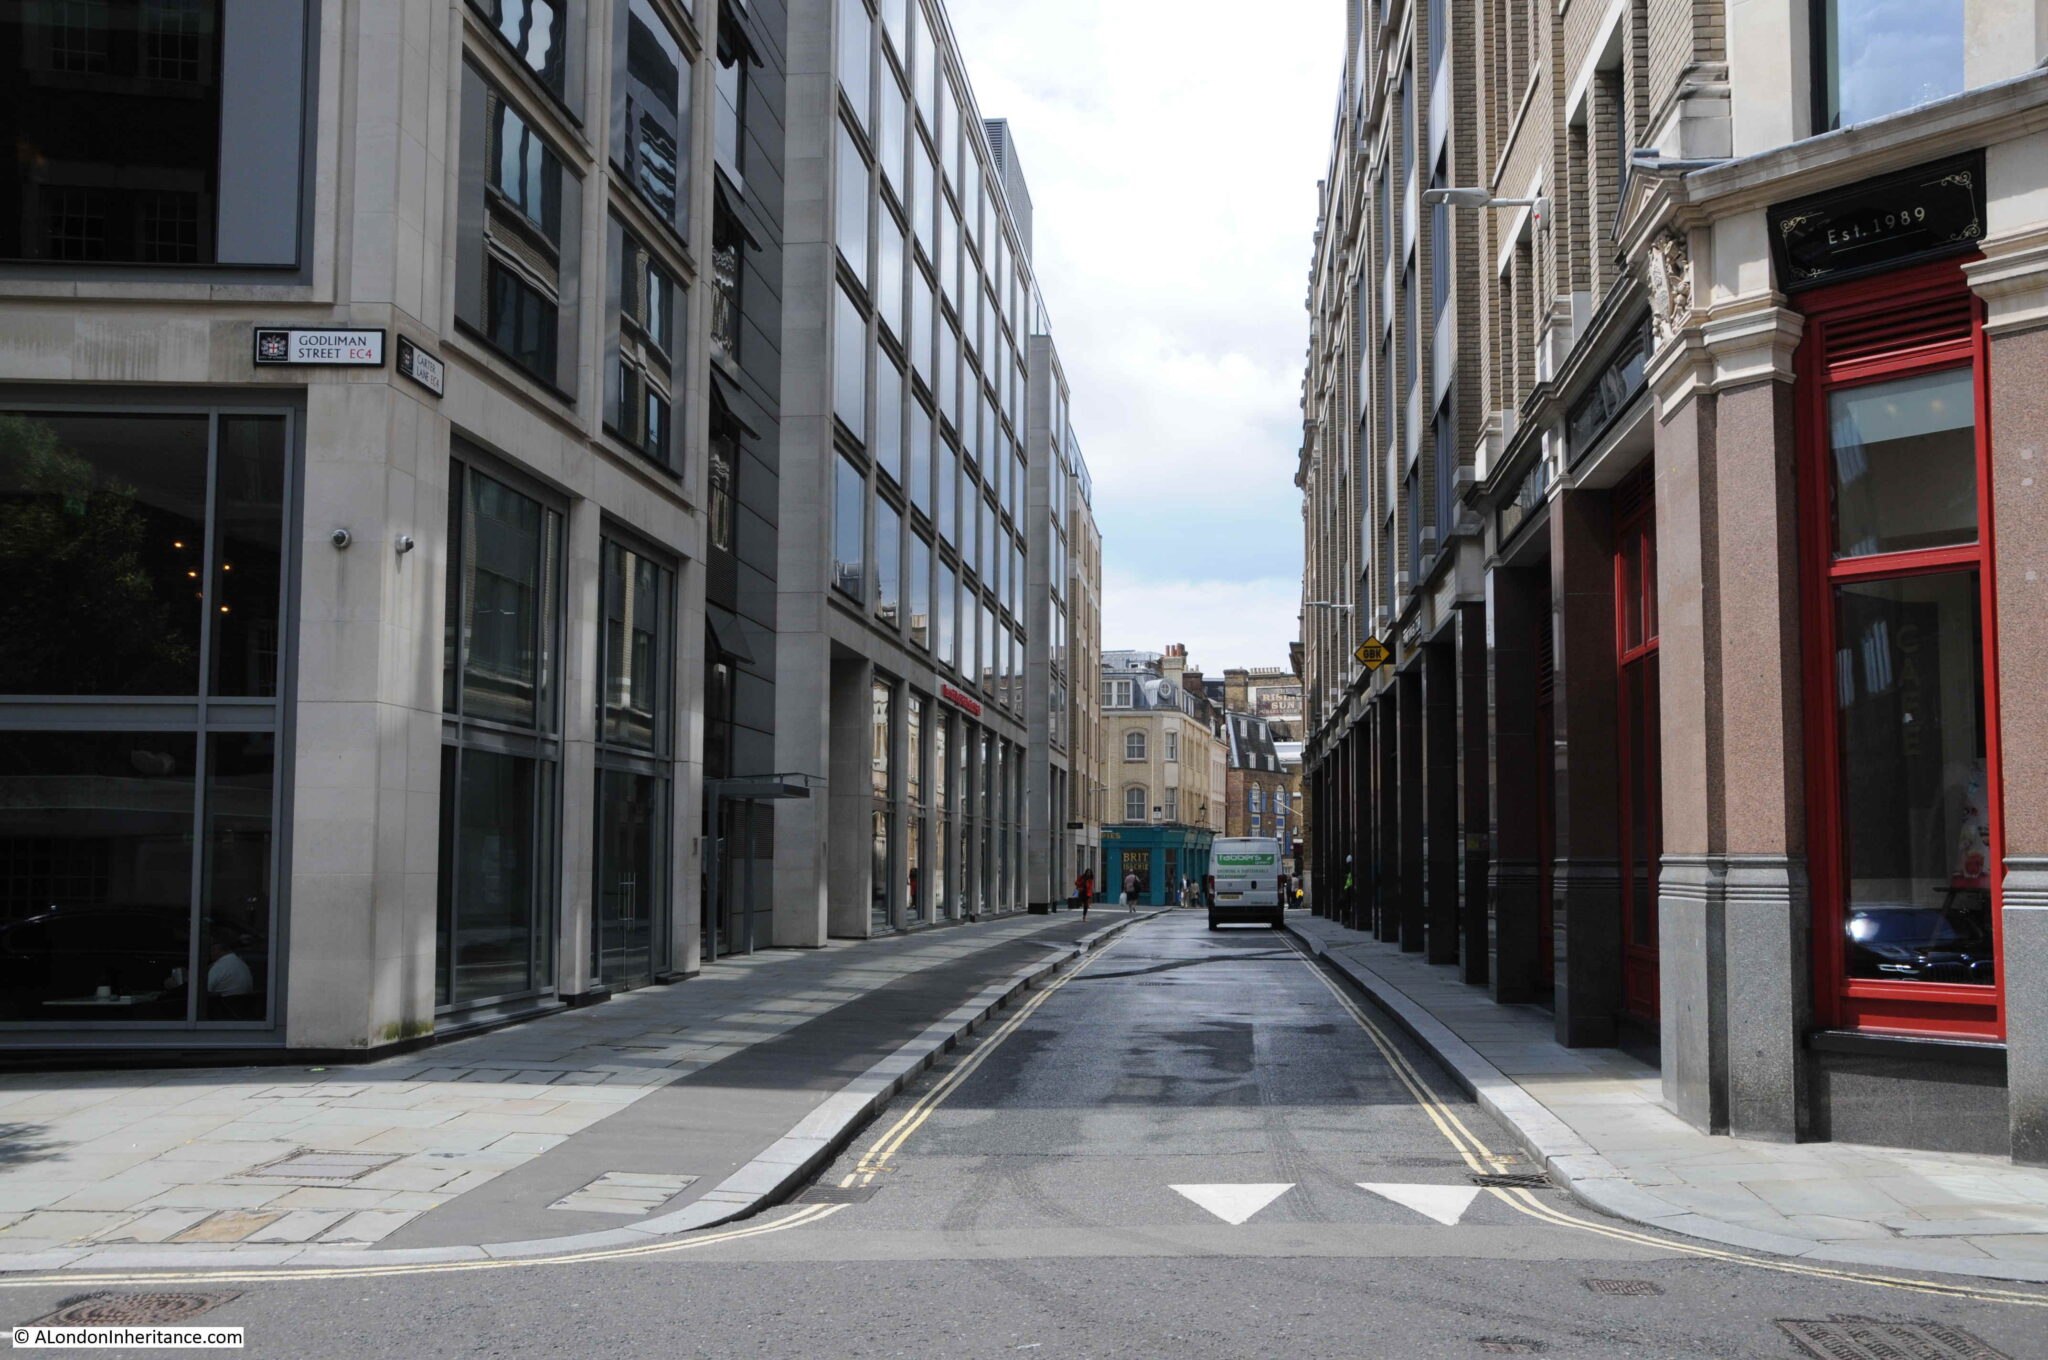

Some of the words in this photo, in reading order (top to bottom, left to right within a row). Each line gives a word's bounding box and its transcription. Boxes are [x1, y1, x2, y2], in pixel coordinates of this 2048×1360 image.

[1827, 225, 1867, 245] Est.
[1874, 207, 1926, 234] 1989
[298, 335, 367, 347] GODLIMAN
[298, 347, 342, 359] STREET
[349, 348, 373, 359] EC4
[1363, 649, 1382, 659] GBK
[1271, 701, 1295, 710] SUN
